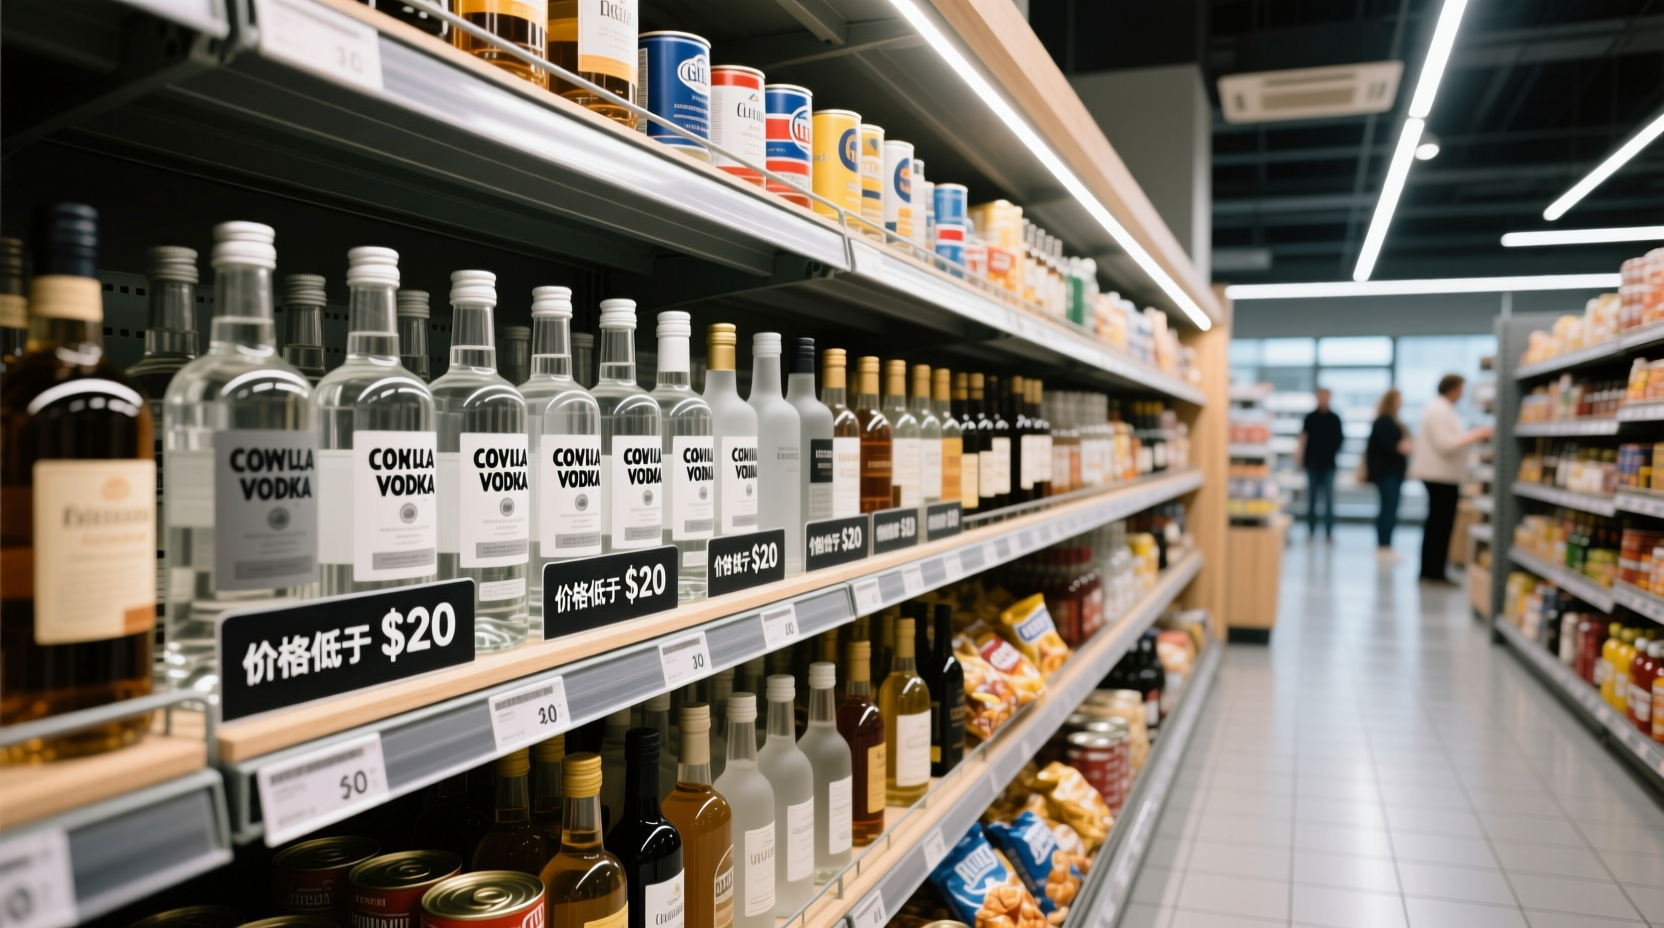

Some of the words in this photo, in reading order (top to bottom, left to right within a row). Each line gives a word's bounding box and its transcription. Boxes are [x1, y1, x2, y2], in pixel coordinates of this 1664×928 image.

[239, 476, 312, 502] VODKA
[376, 473, 435, 497] VODKA
[479, 471, 528, 492] VODKA
[557, 469, 601, 489] VODKA
[842, 525, 862, 552] $20
[751, 541, 778, 575] $20
[554, 576, 621, 614] 价格低于
[625, 563, 666, 605] $20
[242, 624, 372, 686] 价格低于
[381, 602, 456, 662] $20
